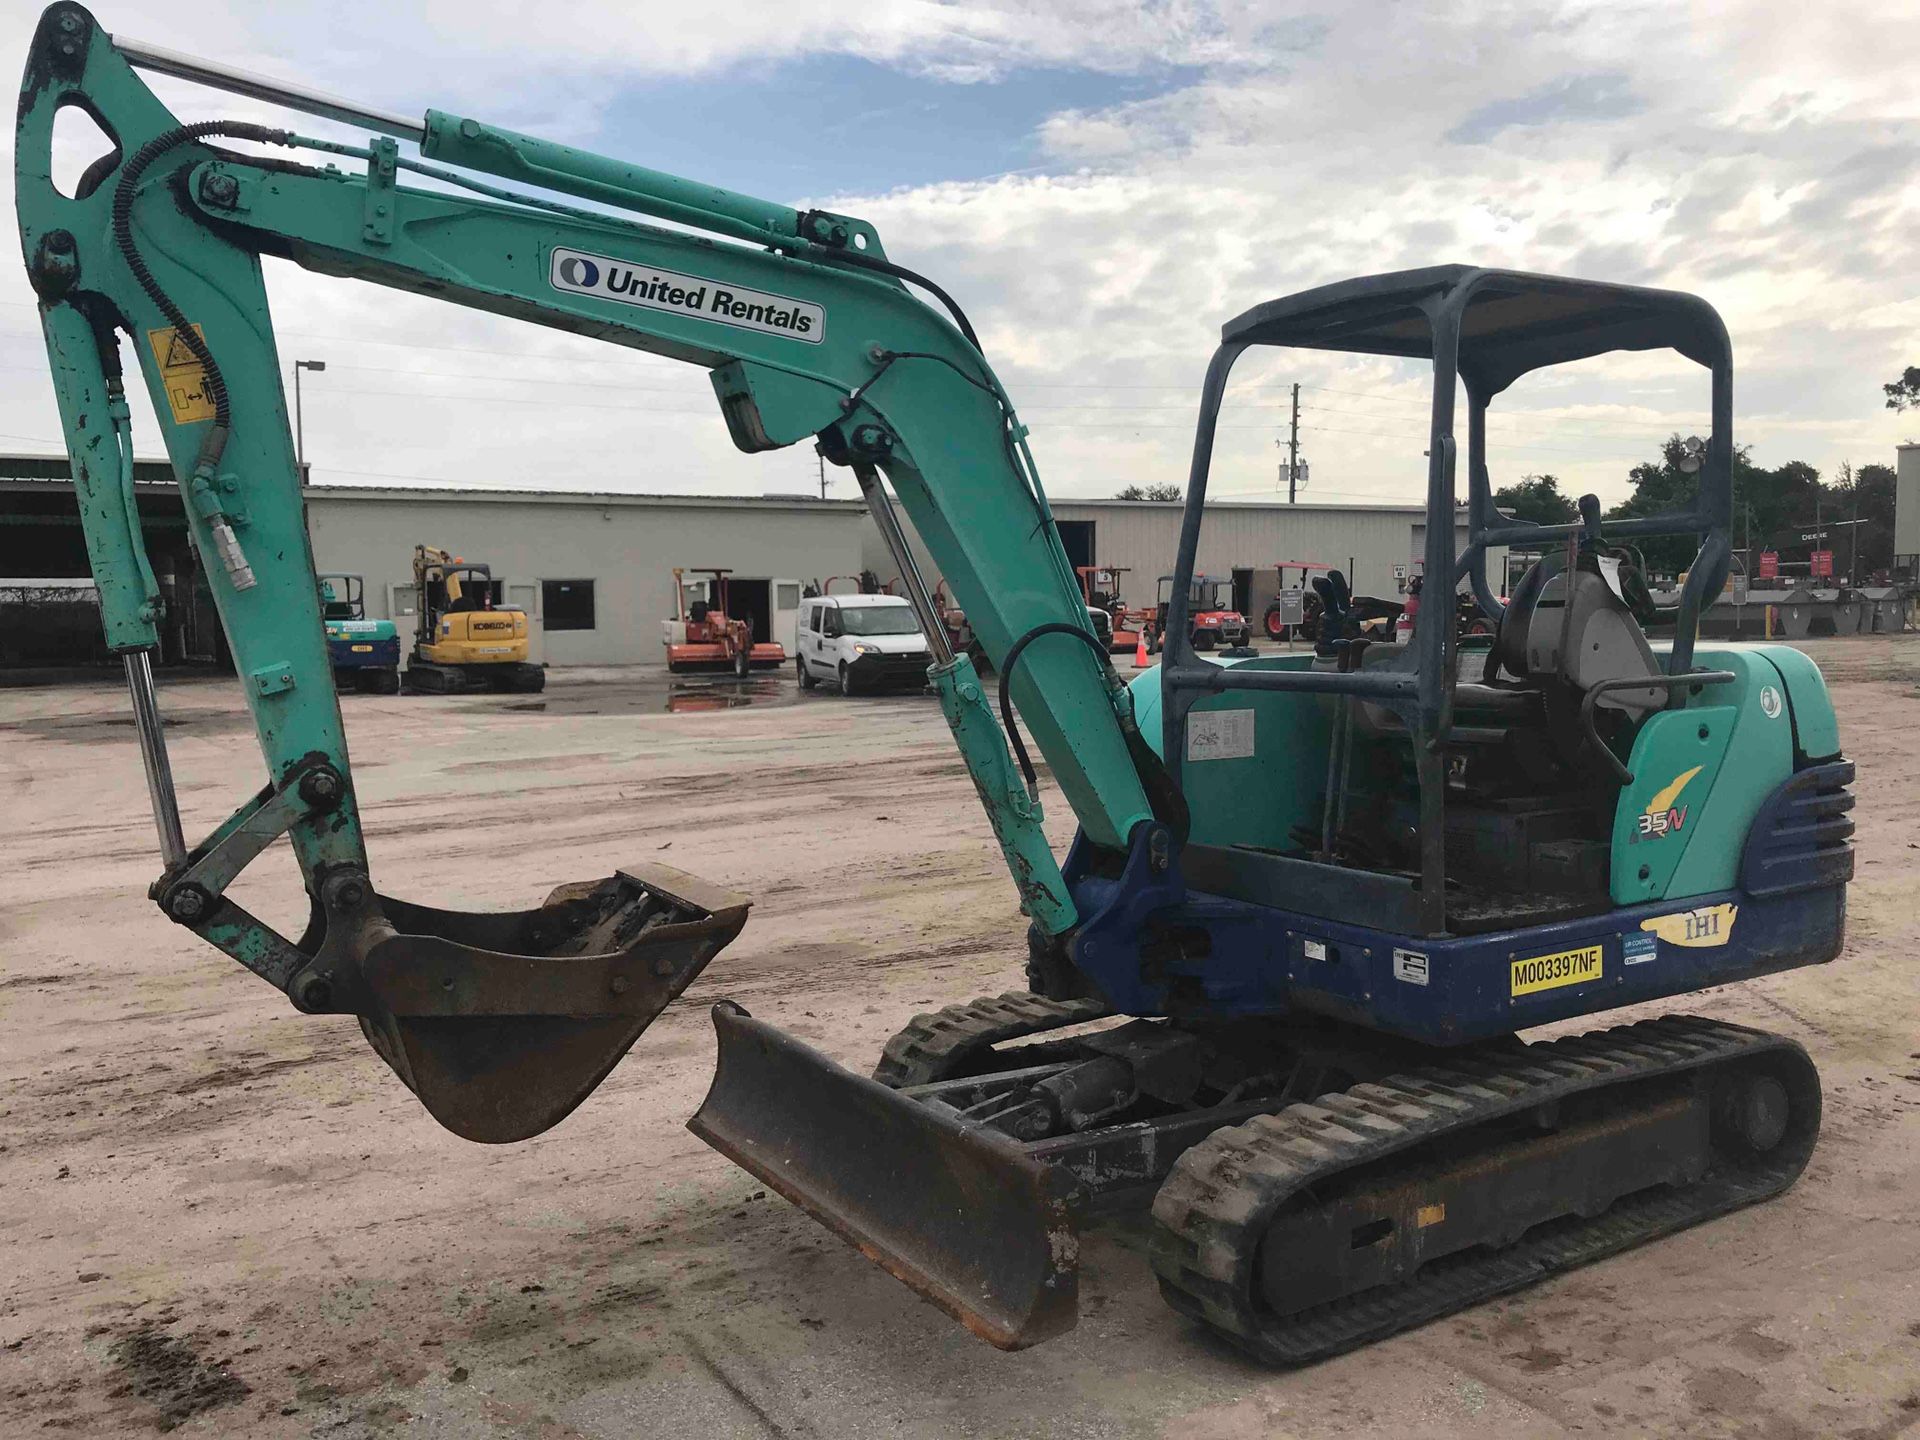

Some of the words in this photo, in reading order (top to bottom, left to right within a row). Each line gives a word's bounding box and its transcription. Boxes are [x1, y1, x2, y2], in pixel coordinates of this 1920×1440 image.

[607, 267, 708, 310] United
[711, 290, 812, 333] Rentals
[1638, 804, 1688, 834] 35N
[1685, 912, 1720, 941] IHI
[1514, 950, 1597, 987] M003397NF
